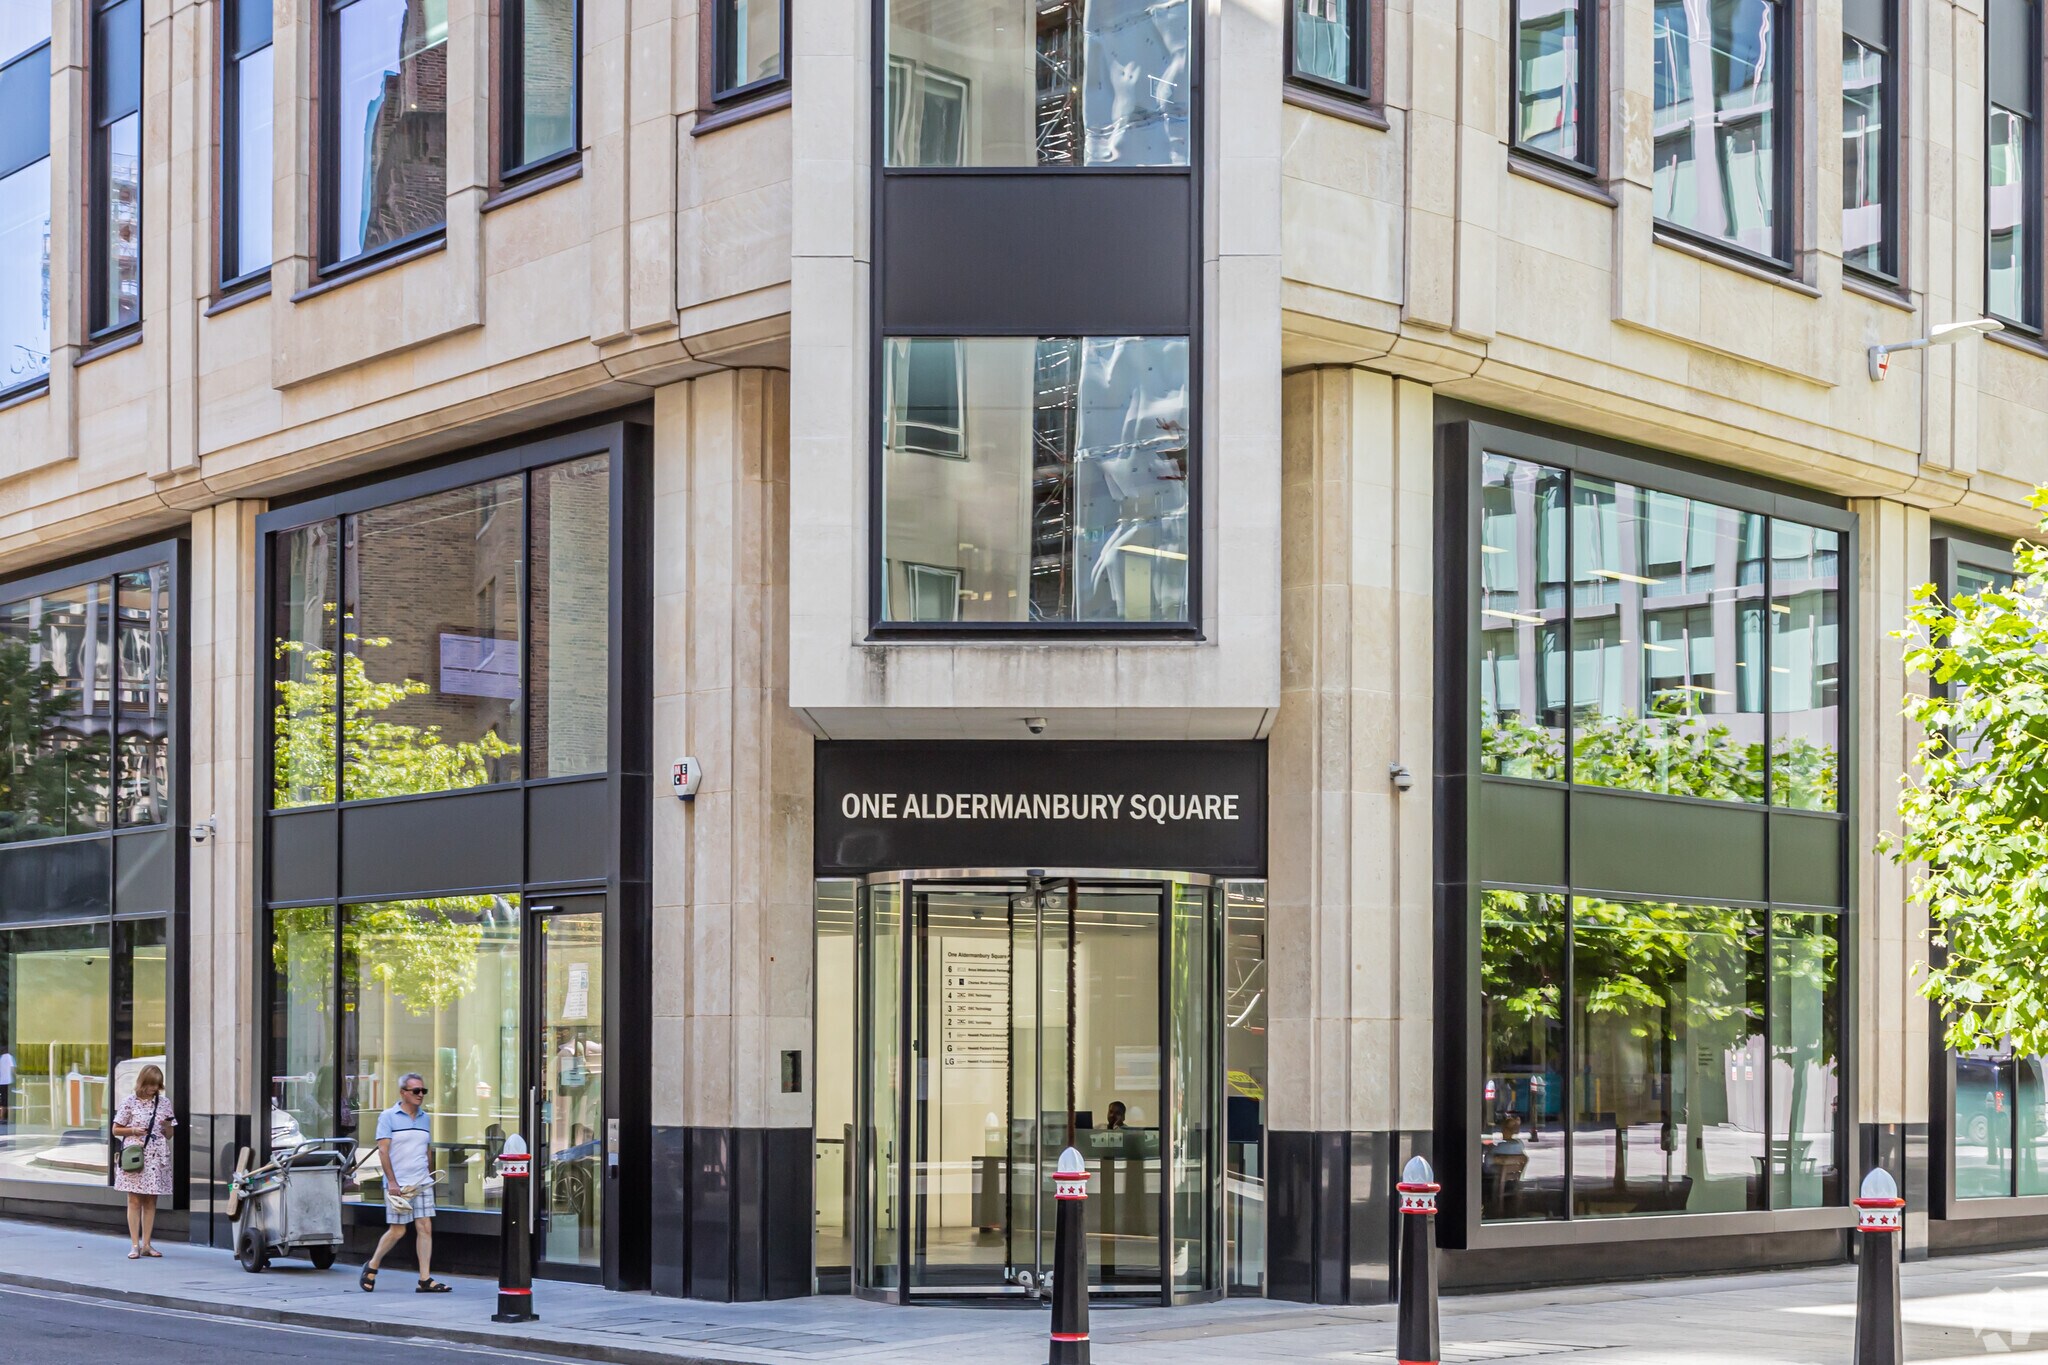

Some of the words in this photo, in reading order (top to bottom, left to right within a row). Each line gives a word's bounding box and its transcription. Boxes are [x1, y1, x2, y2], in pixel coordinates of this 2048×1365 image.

[842, 793, 898, 819] ONE
[902, 793, 1125, 820] ALDERMANBURY
[1129, 794, 1240, 825] SQUARE
